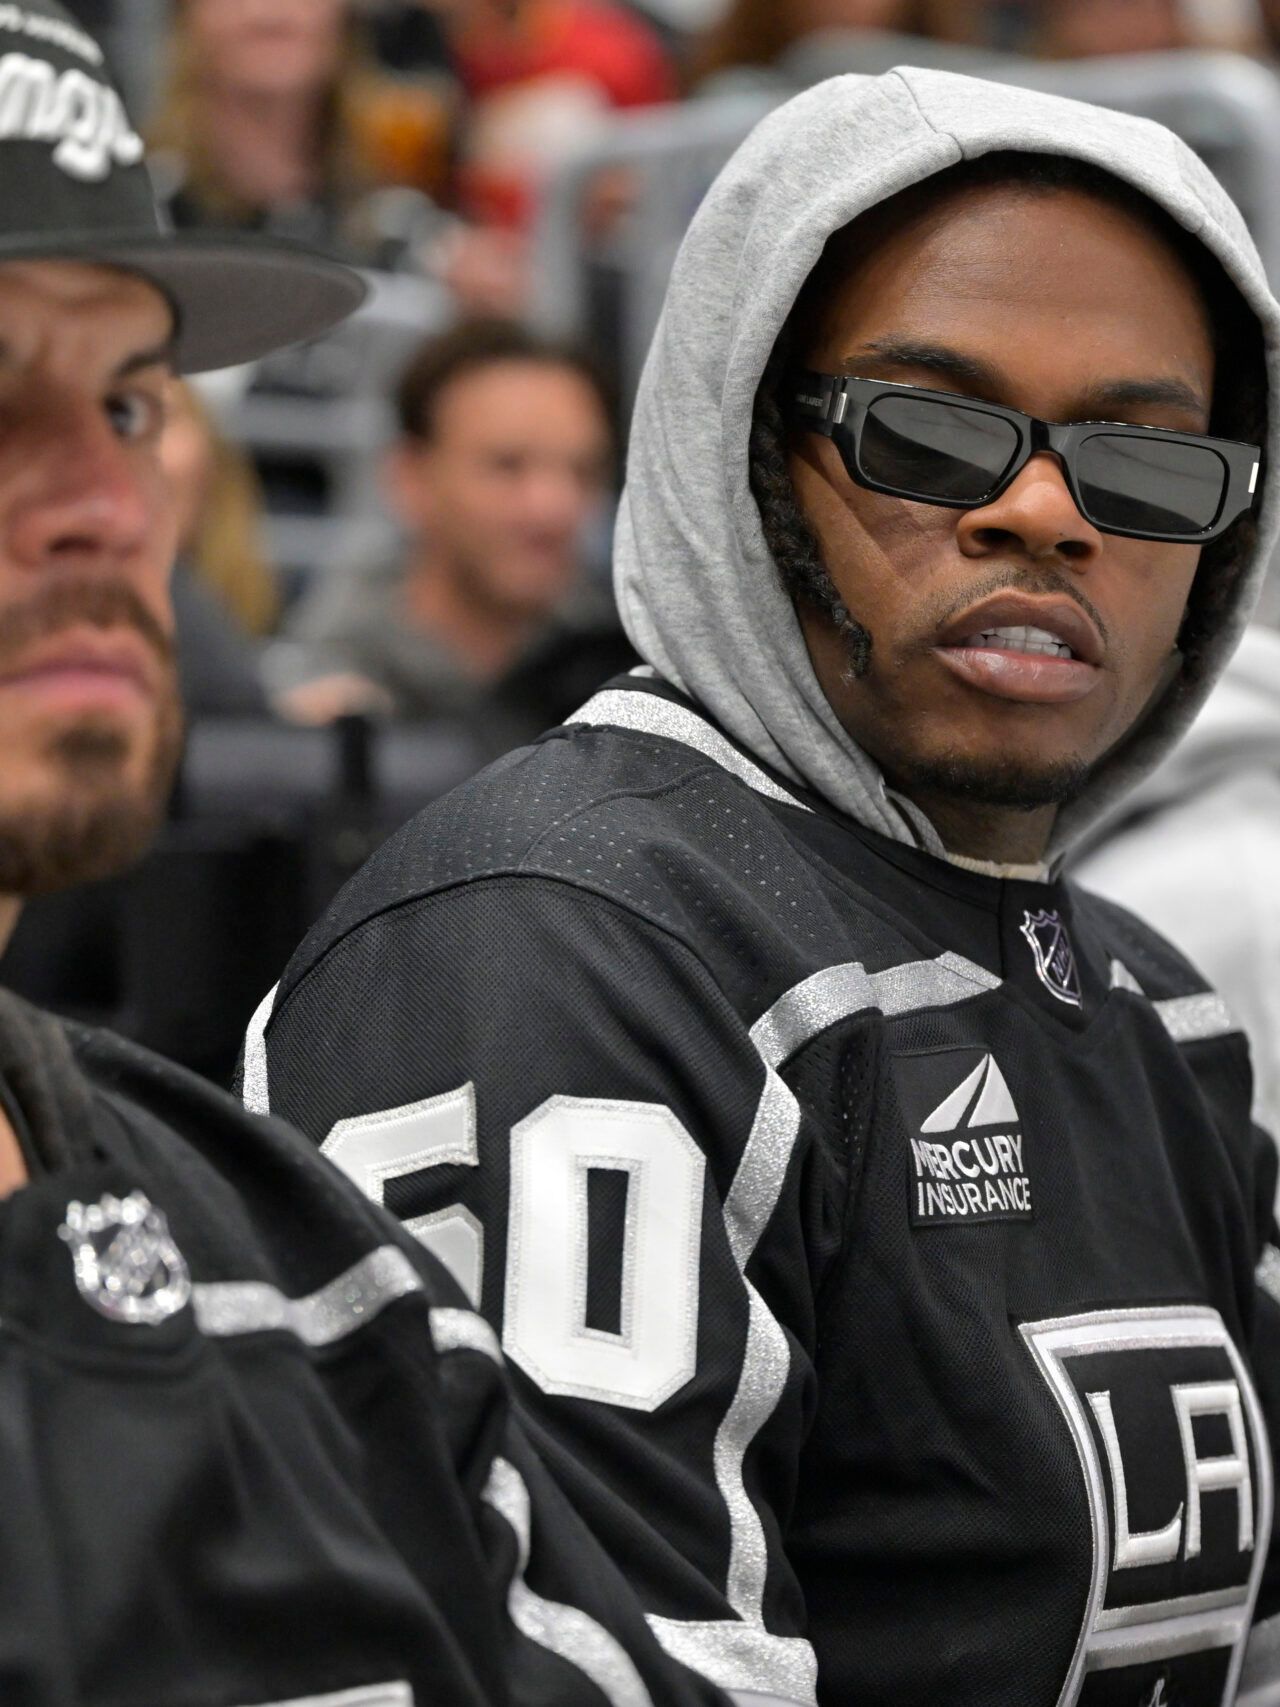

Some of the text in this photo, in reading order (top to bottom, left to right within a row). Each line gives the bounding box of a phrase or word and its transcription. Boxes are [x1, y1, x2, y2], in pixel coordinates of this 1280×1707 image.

[910, 1134, 1024, 1180] MERCURY
[917, 1177, 1032, 1216] INSURANCE
[1085, 1378, 1254, 1571] LA
